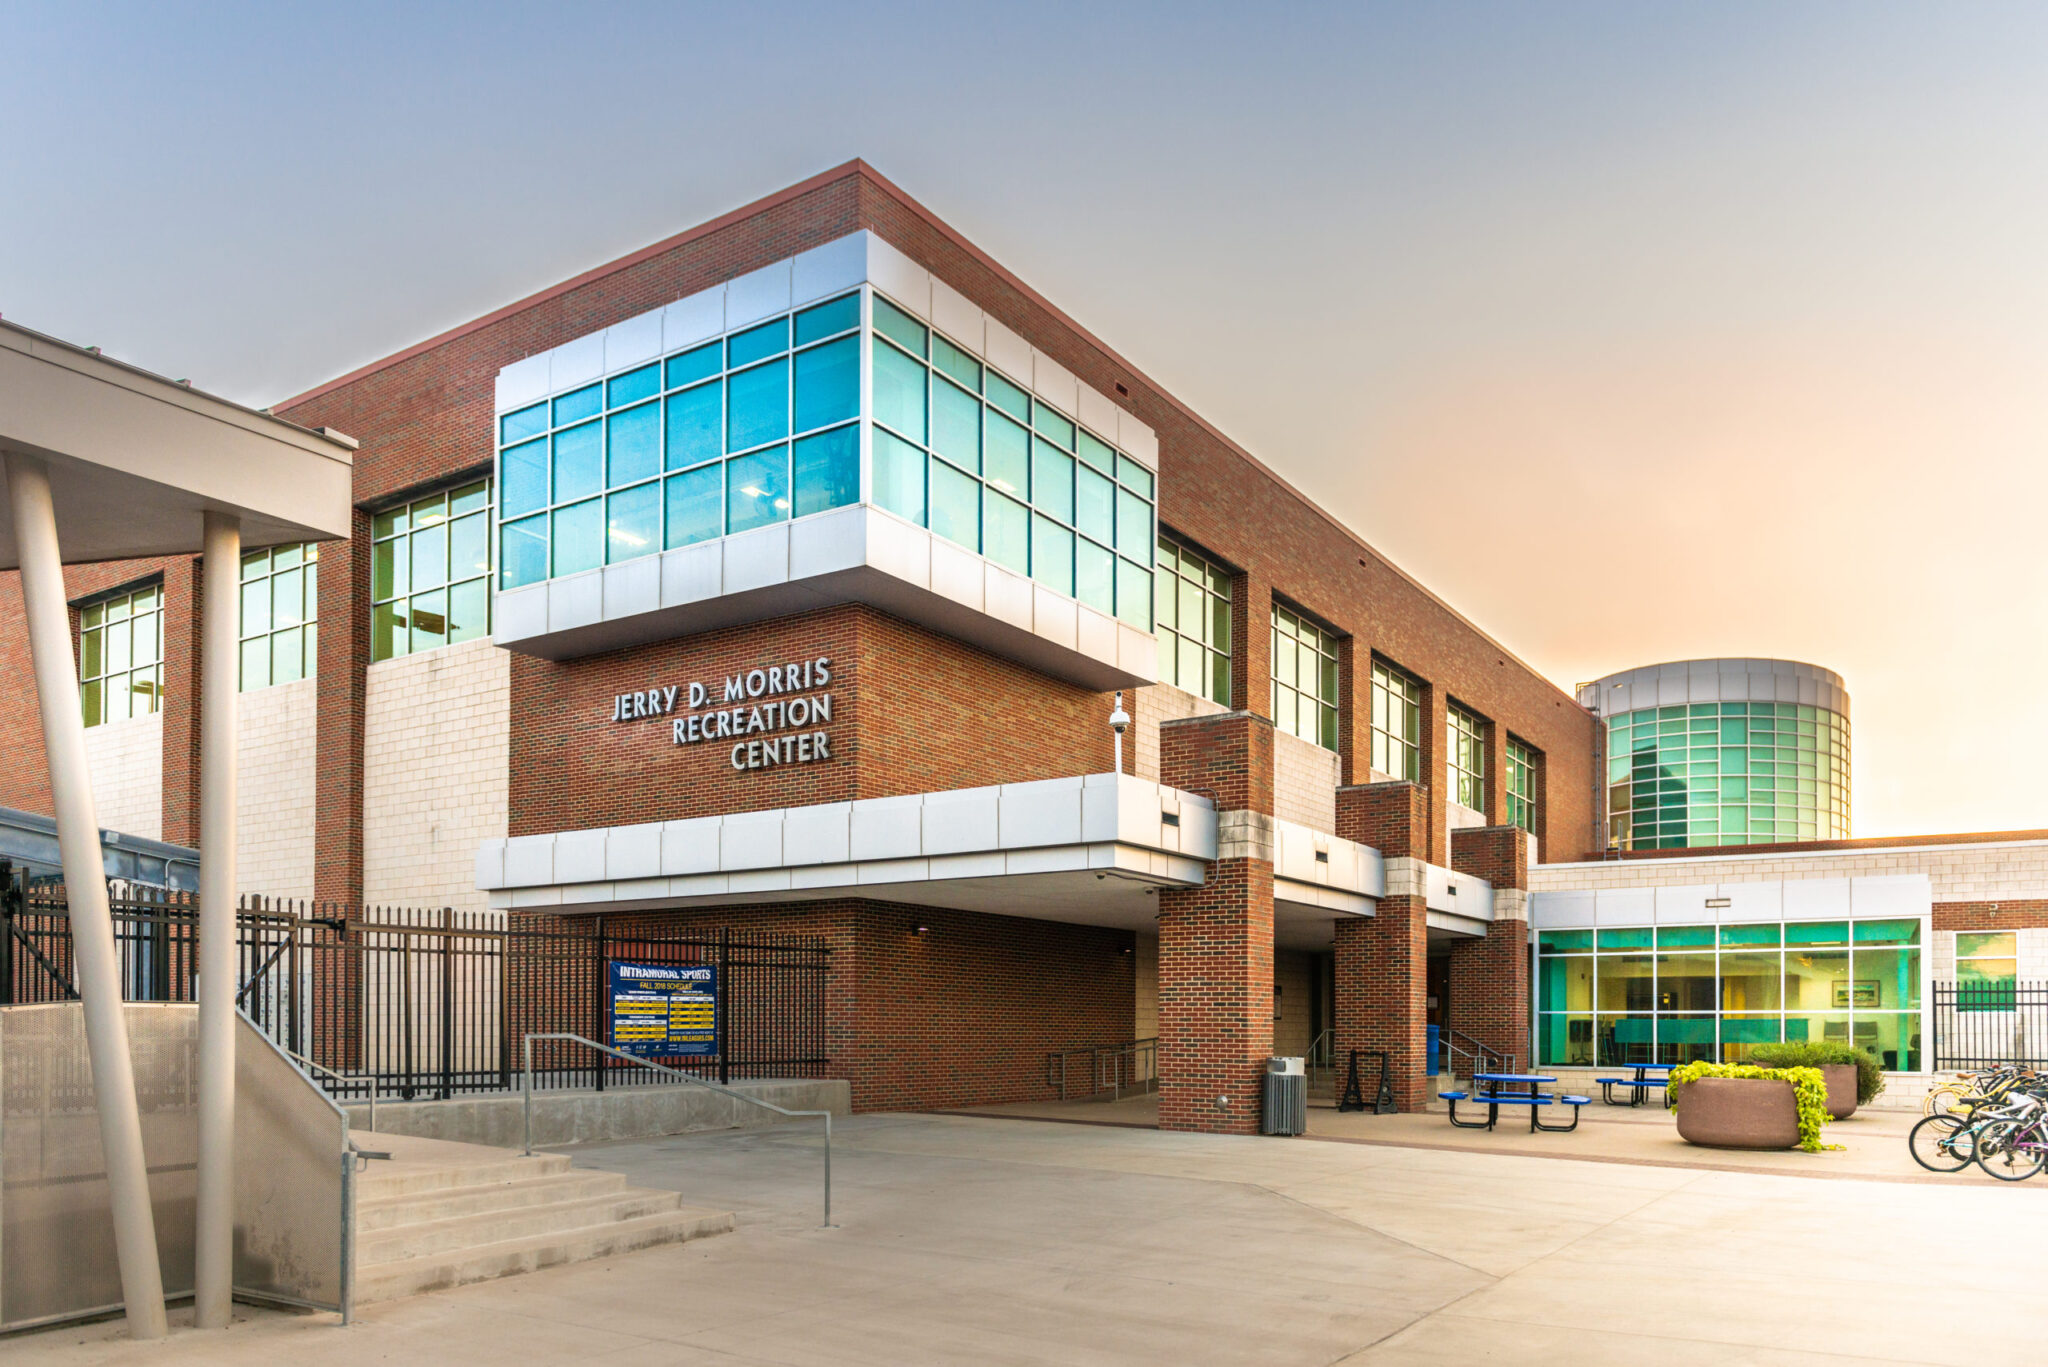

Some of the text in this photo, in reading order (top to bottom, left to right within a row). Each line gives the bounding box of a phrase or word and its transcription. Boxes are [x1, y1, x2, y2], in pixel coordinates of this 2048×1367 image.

[612, 657, 832, 721] JERRY D. MORRIS
[673, 694, 832, 744] RECREATION
[731, 732, 831, 770] CENTER
[620, 966, 711, 980] INTRAMURAL SPORTS
[667, 982, 693, 990] SCHEDULE
